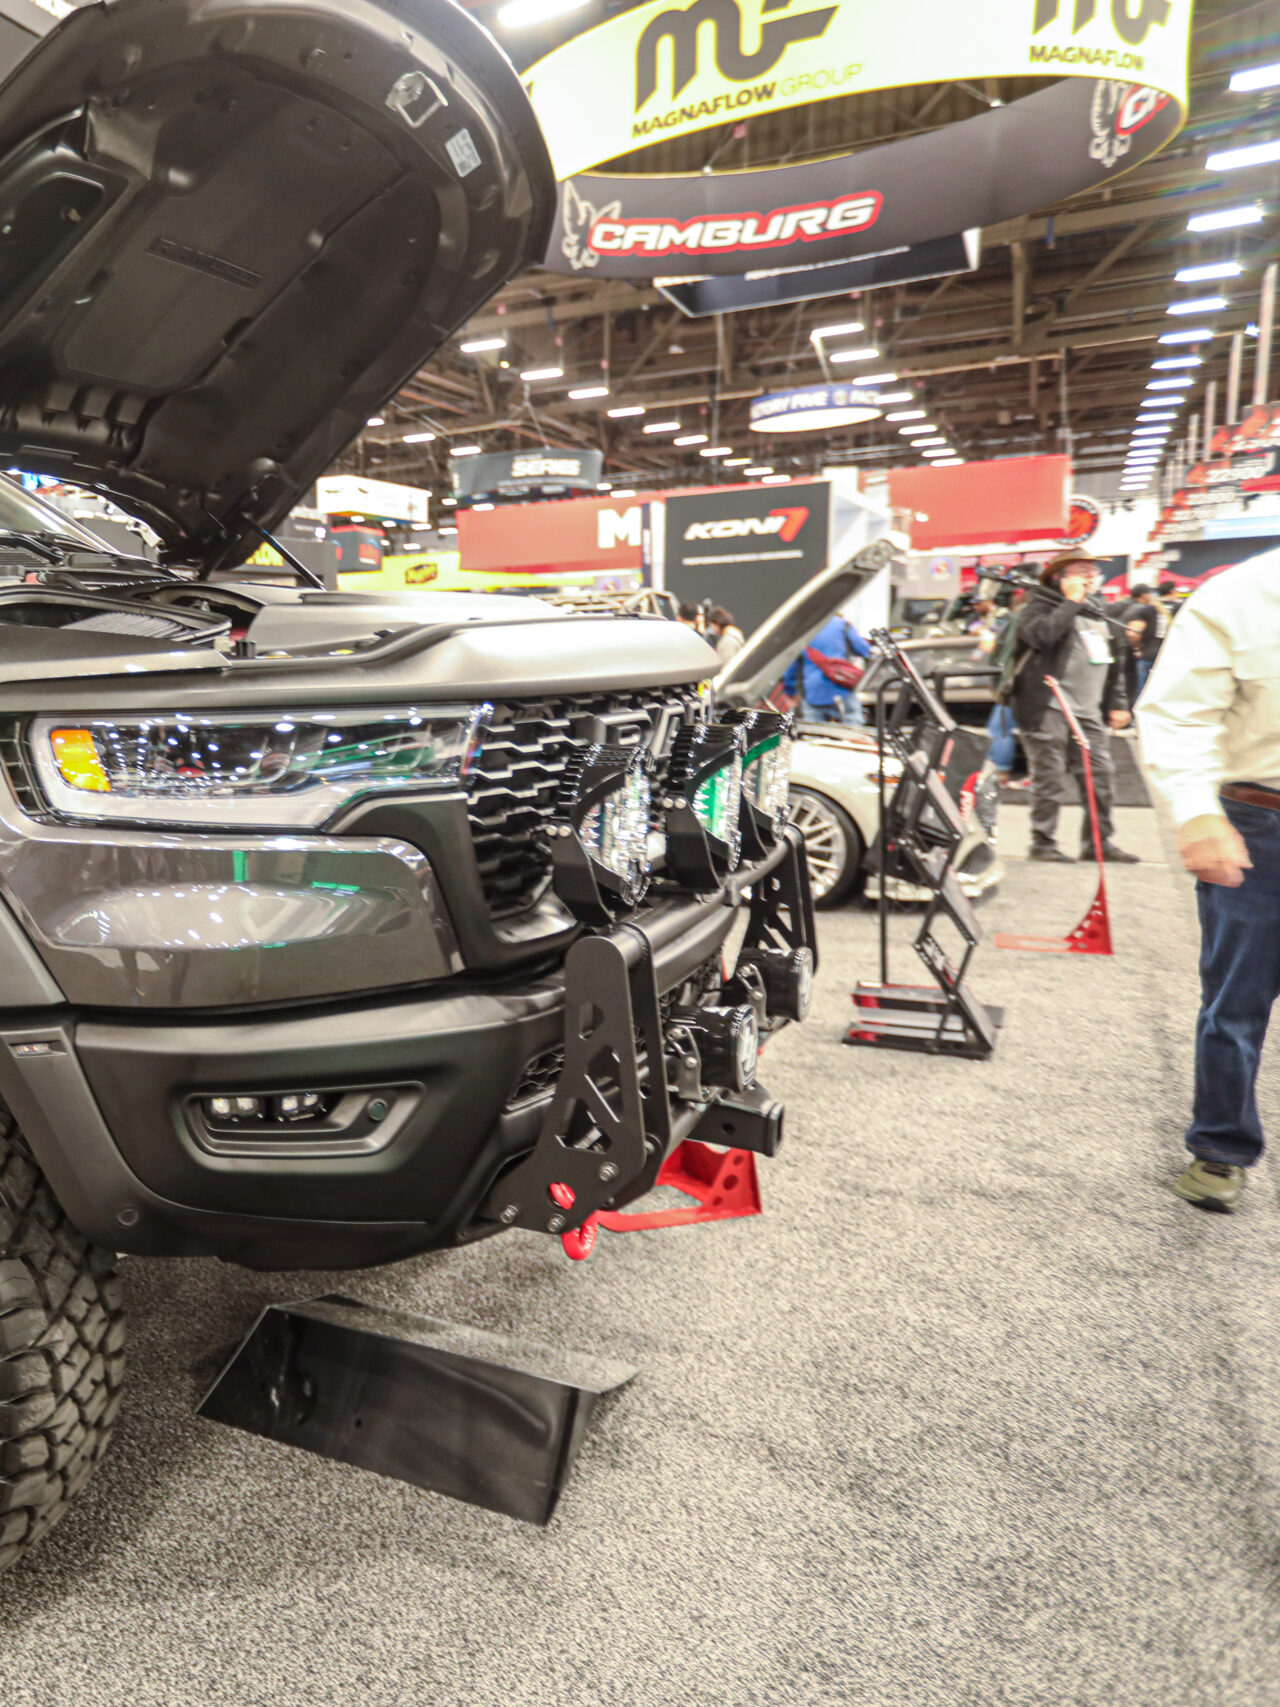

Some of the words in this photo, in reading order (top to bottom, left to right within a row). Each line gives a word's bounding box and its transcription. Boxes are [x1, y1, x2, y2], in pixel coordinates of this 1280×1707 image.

[1028, 45, 1145, 71] MAGNAFLOW
[631, 82, 777, 139] MAGNAFLOW
[779, 63, 864, 97] GROUP
[589, 196, 877, 252] CAMBURG
[597, 505, 643, 550] M
[683, 508, 800, 542] KONI
